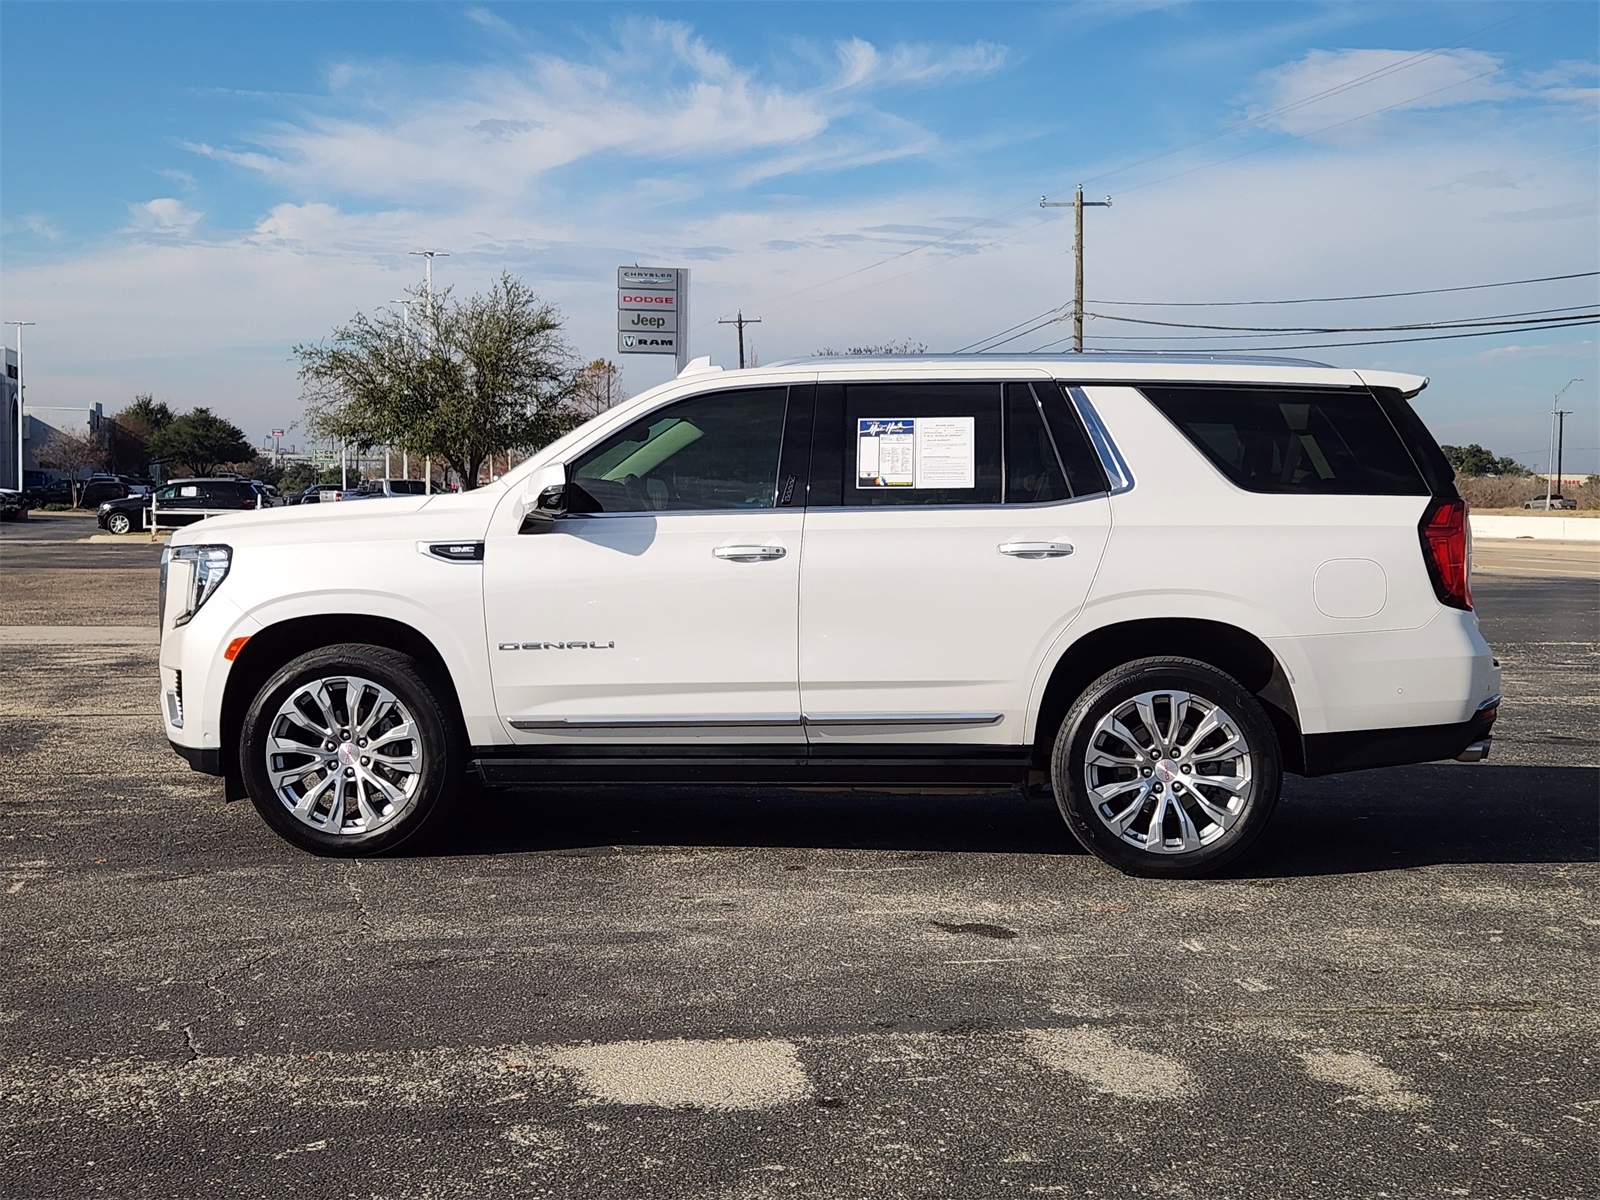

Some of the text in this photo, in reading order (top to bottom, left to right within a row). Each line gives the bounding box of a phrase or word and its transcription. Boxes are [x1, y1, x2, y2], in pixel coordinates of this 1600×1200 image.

[623, 296, 674, 304] DODGE
[631, 313, 665, 328] Jeep
[498, 640, 615, 651] DENALI
